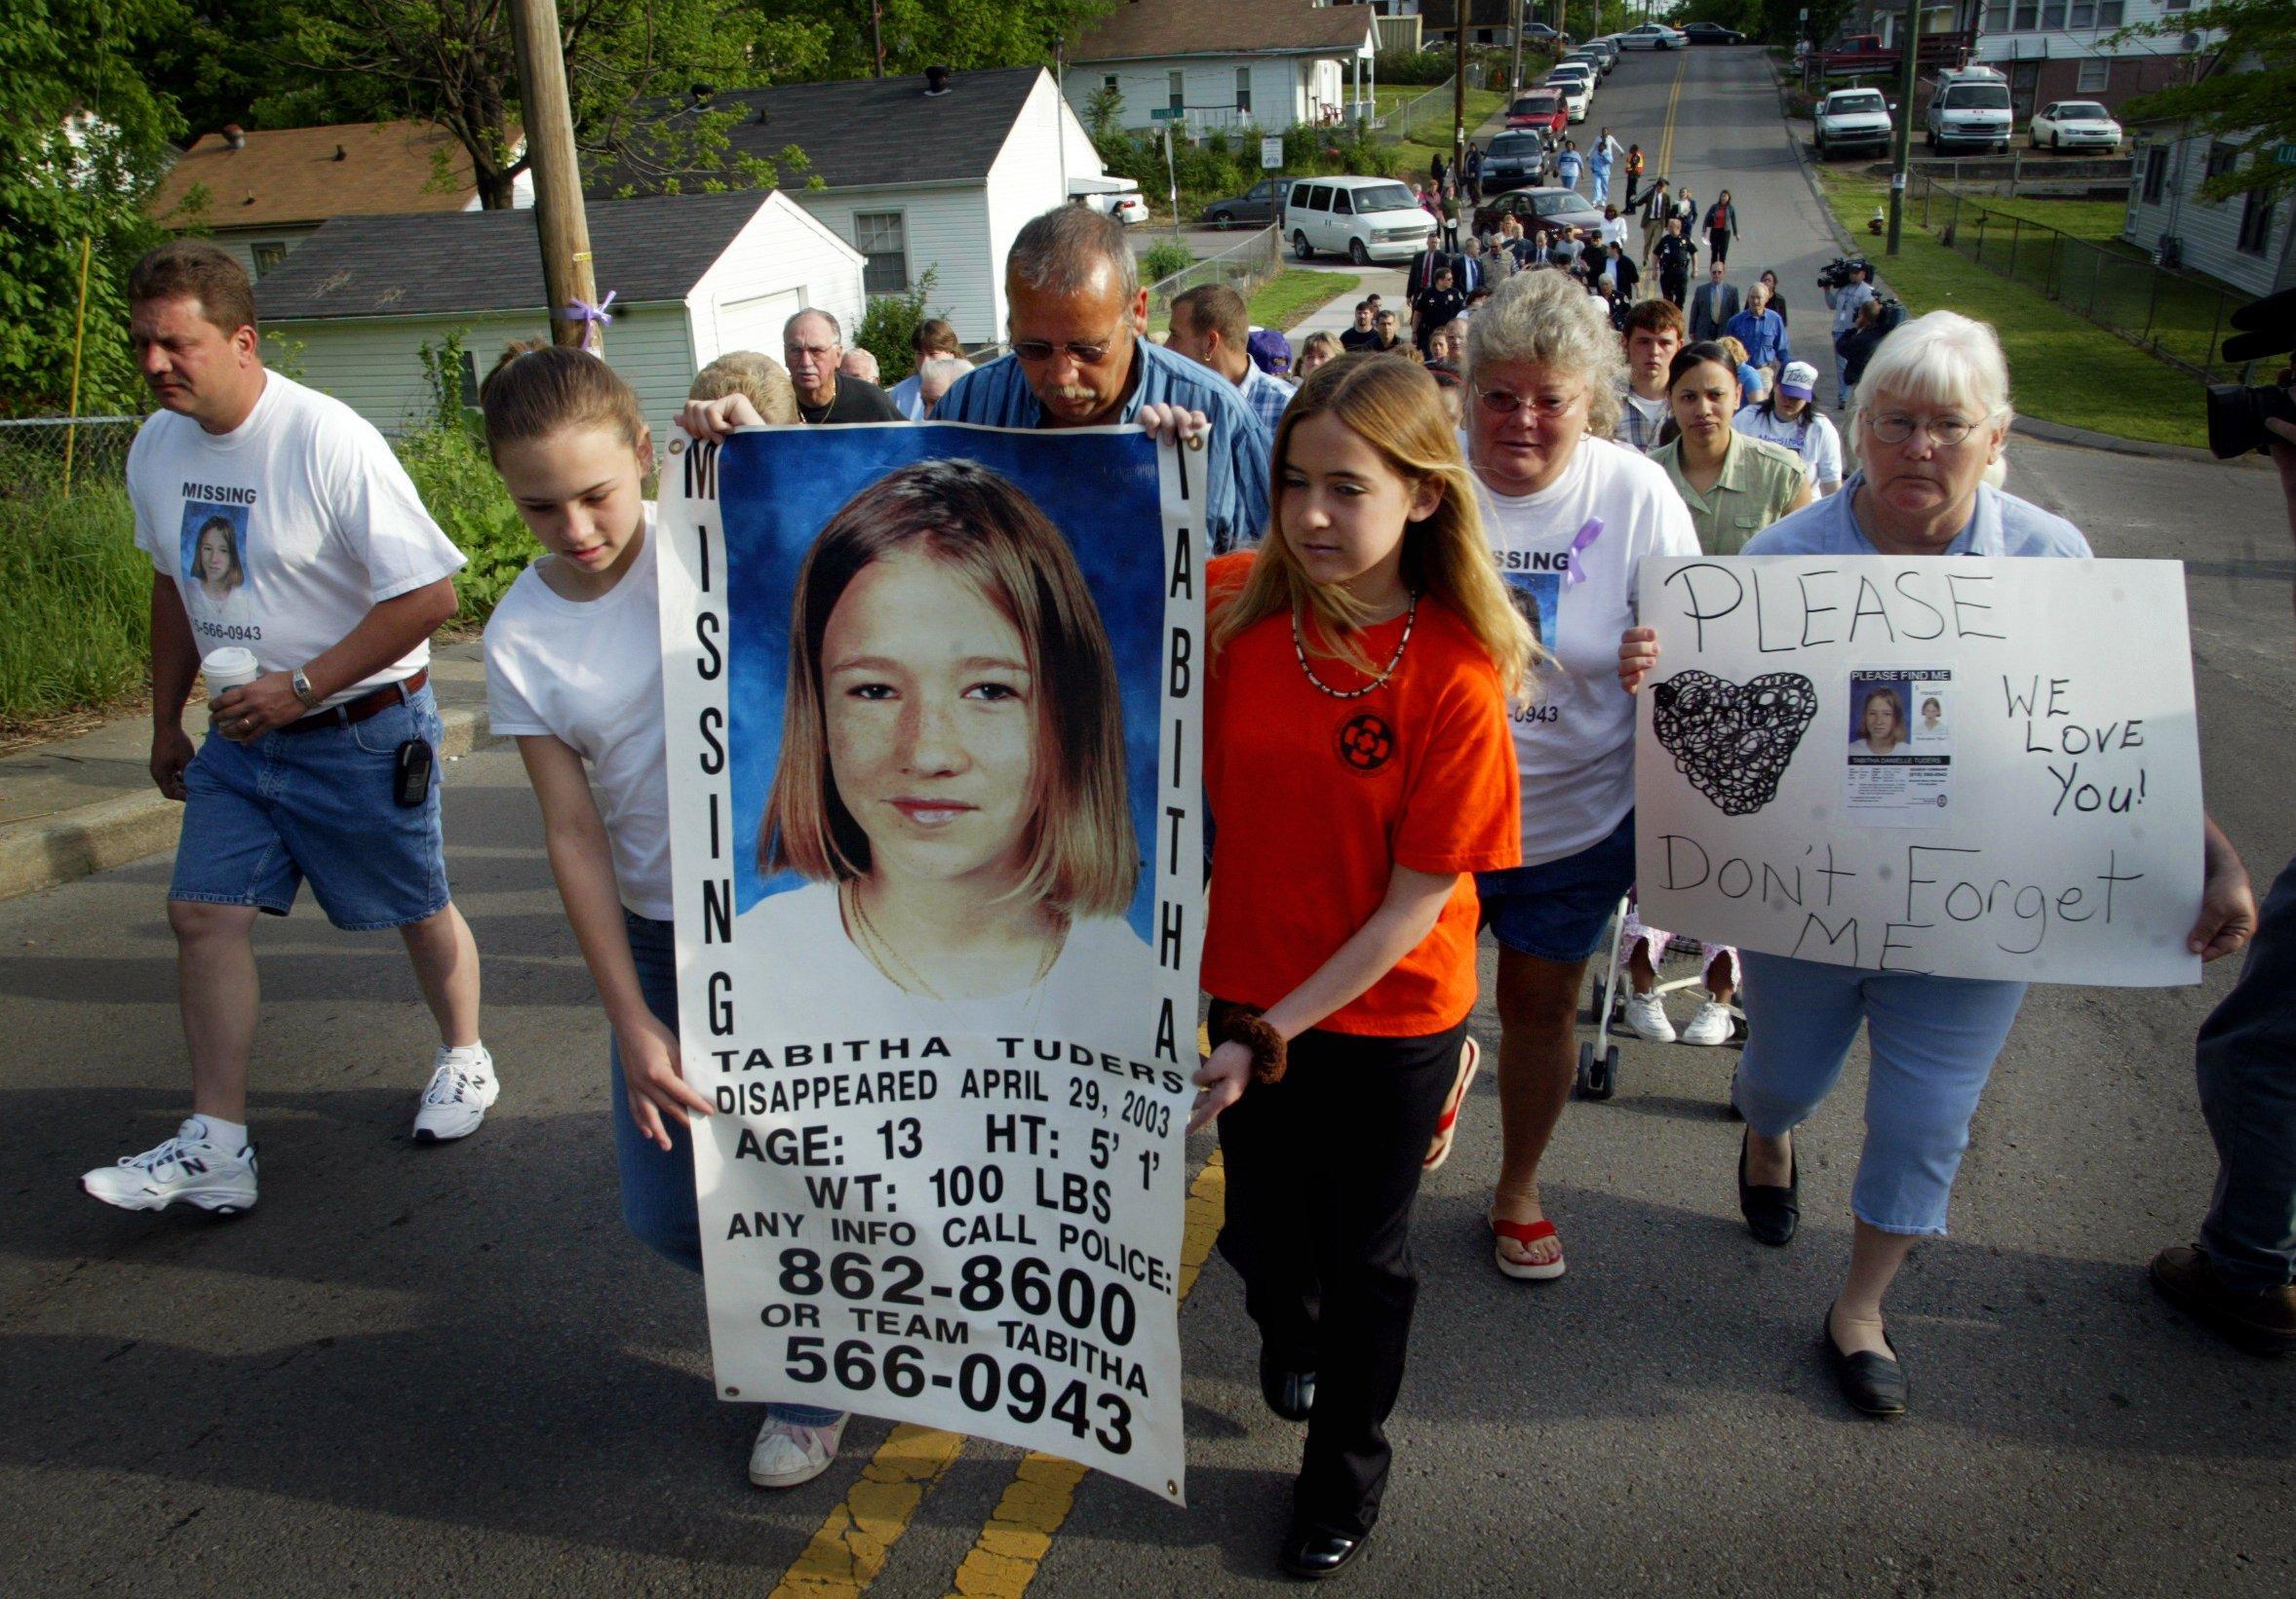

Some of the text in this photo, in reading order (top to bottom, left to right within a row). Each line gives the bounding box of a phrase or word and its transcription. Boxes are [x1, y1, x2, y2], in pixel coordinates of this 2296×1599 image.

[181, 482, 257, 504] MISSING
[1493, 551, 1570, 571] SSING
[191, 617, 262, 640] 5-566-0943
[1664, 564, 2006, 653] PLEASE
[1852, 671, 1949, 681] PLEASE FIND ME
[2004, 674, 2071, 718] WE
[684, 439, 734, 1036] MISSING
[1508, 706, 1558, 722] -0943
[2026, 720, 2145, 756] LOVE
[2048, 762, 2146, 816] You!
[1905, 845, 2144, 955] Forget
[1791, 913, 1936, 975] ME
[712, 1036, 1185, 1094] TABITHA TUDERS
[717, 1069, 1171, 1138] DISAPPEARED APRIL 29, 2003
[735, 1114, 1160, 1190] AGE: 13 HT: 5' 1'
[805, 1164, 1111, 1224] WT: 100 LBS
[726, 1212, 1172, 1295] ANY INFO CALL POLICE:
[778, 1248, 1136, 1346] 862-8600
[760, 1304, 1148, 1397] OR TEAM TABITHA
[785, 1337, 1133, 1455] 566-0943
